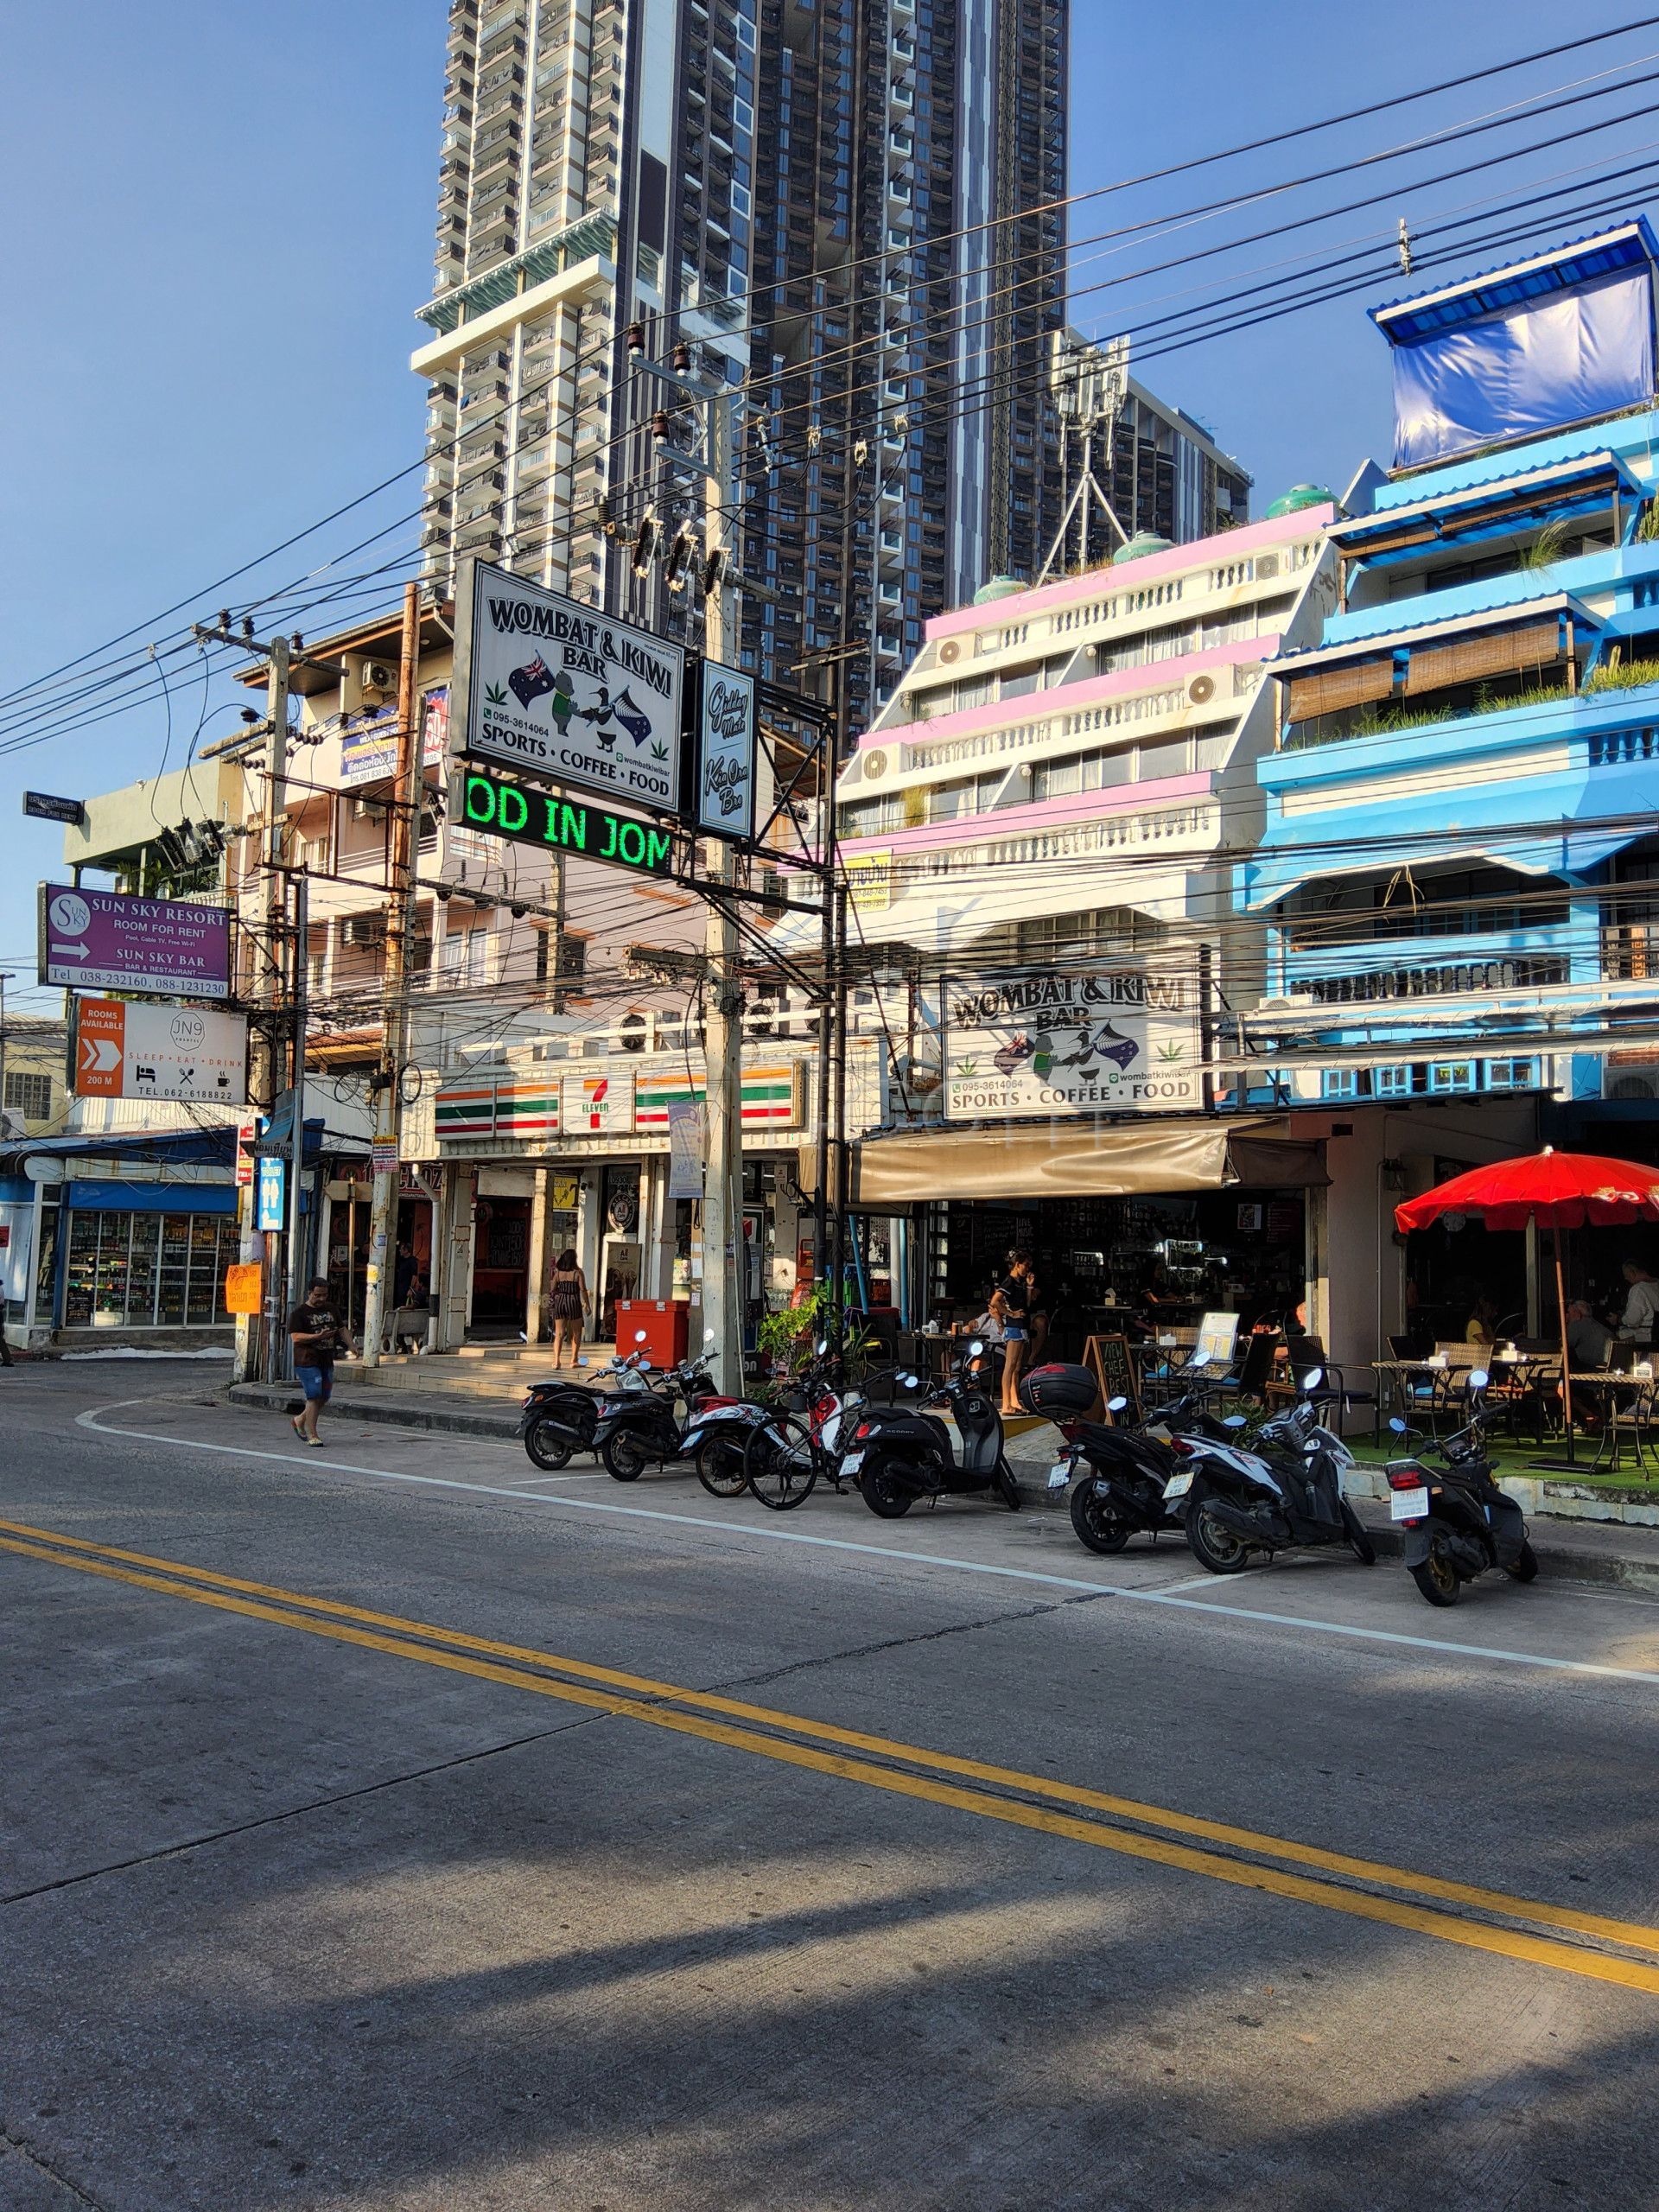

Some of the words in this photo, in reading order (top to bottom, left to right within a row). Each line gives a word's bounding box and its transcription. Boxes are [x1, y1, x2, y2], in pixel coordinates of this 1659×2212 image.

[486, 597, 599, 652] WOMBAT
[600, 629, 623, 662] &
[622, 639, 673, 699] KIWI
[562, 645, 610, 683] BAR
[493, 710, 549, 737] 095-3614064
[721, 716, 746, 739] Mate
[482, 723, 547, 758] SPORTS
[560, 749, 616, 779] COFFEE
[629, 770, 670, 796] FOOD
[624, 754, 671, 777] wombatkiwibar
[705, 756, 728, 796] Kia
[728, 759, 748, 785] Ora
[467, 777, 527, 831] OD
[543, 800, 586, 849] IN
[720, 787, 743, 816] Bro
[92, 899, 125, 913] SUN
[131, 904, 161, 918] SKY
[166, 907, 226, 926] RESORT
[114, 920, 147, 932] ROOM
[152, 924, 174, 935] FOR
[179, 927, 206, 938] RENT
[117, 949, 144, 961] SUN
[149, 952, 175, 964] SKY
[179, 955, 206, 968] BAR
[150, 966, 197, 976] RESTAURANT
[52, 968, 70, 981] Tel
[156, 978, 225, 995] 088-1231230
[1081, 976, 1111, 1005] &
[80, 1019, 124, 1031] AVAILABLE
[88, 1009, 118, 1020] ROOMS
[1034, 1006, 1096, 1035] BAR
[174, 1020, 202, 1037] JN9
[129, 1052, 164, 1061] SLEEP
[209, 1058, 243, 1068] DRINK
[86, 1076, 102, 1085] 200
[105, 1077, 112, 1085] M
[963, 1079, 1023, 1091] 095-3614064
[583, 1079, 608, 1128] 7
[952, 1090, 1020, 1109] SPORTS
[1039, 1084, 1110, 1104] COFFEE
[1133, 1081, 1191, 1100] FOOD
[1104, 1359, 1125, 1376] CHEF
[1109, 1375, 1130, 1395] BEST
